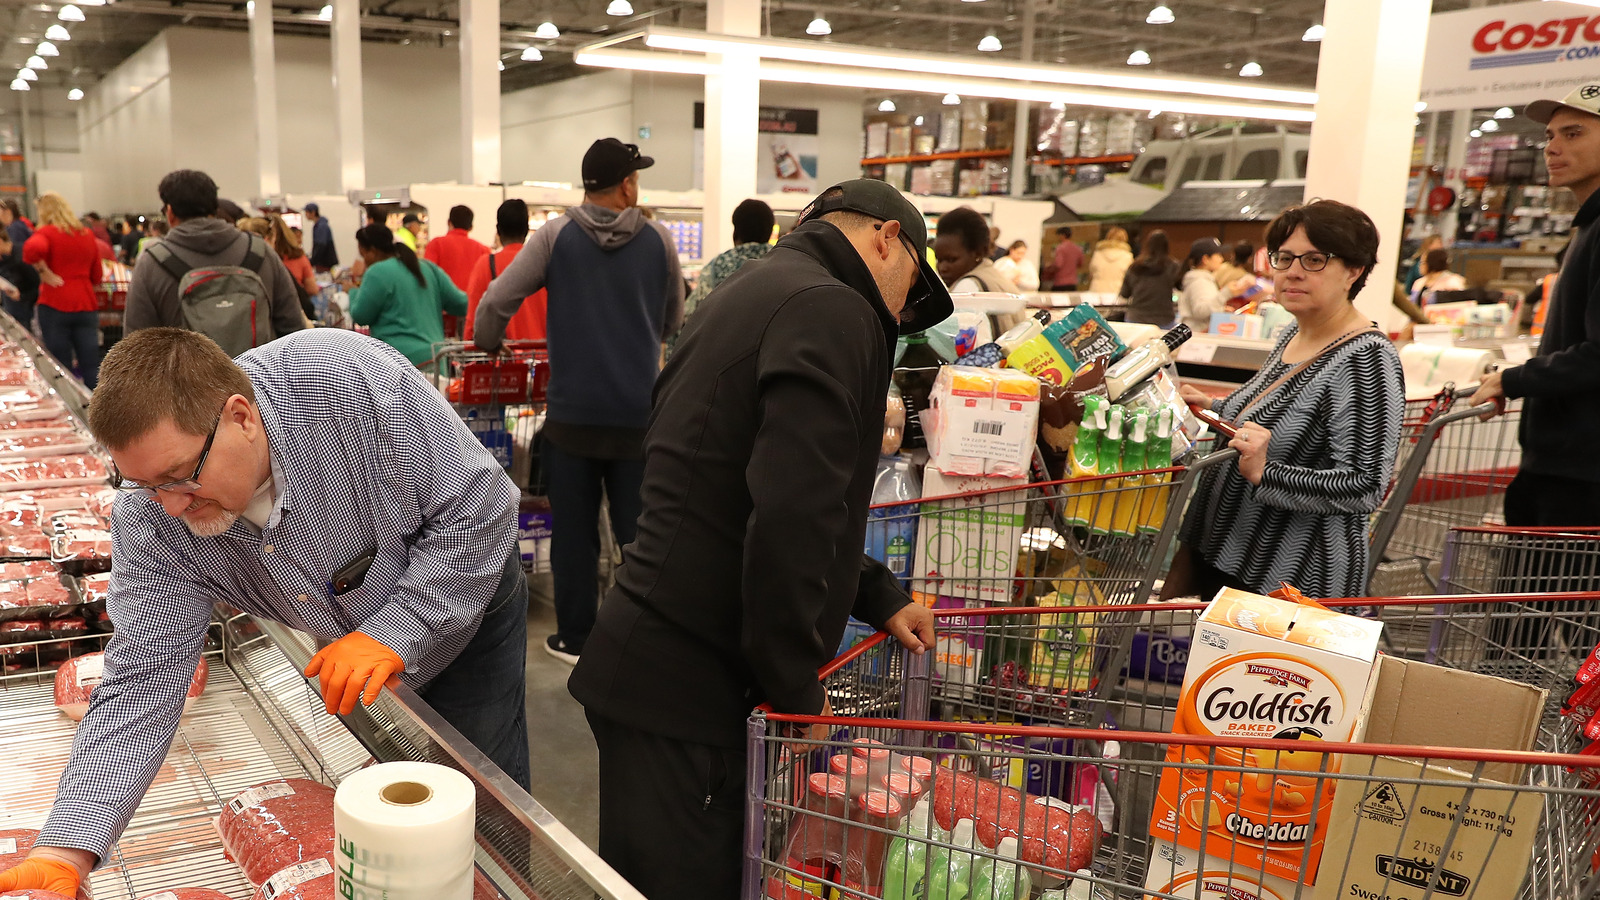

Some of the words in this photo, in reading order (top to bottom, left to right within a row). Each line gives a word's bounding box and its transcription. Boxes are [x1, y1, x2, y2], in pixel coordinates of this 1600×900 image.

[1492, 80, 1542, 94] Exclusive
[1093, 334, 1110, 348] FOR
[1080, 344, 1095, 356] ALL
[1030, 357, 1055, 376] PACK
[988, 514, 1013, 523] TASTE
[979, 526, 1005, 536] olled
[926, 532, 1009, 572] Oats
[1250, 664, 1288, 678] PEPPERIDGE
[1288, 672, 1306, 686] FARM
[1203, 686, 1332, 724] Goldfish
[1228, 722, 1277, 732] BAKED
[1212, 790, 1228, 804] CHEESE
[1166, 810, 1176, 822] 3
[1368, 813, 1394, 826] CAUTION
[1420, 806, 1446, 820] Gross
[1449, 812, 1482, 829] Wight:
[1480, 808, 1496, 820] 730
[1413, 840, 1464, 862] 213845
[1208, 882, 1243, 897] PEPPEIDGE
